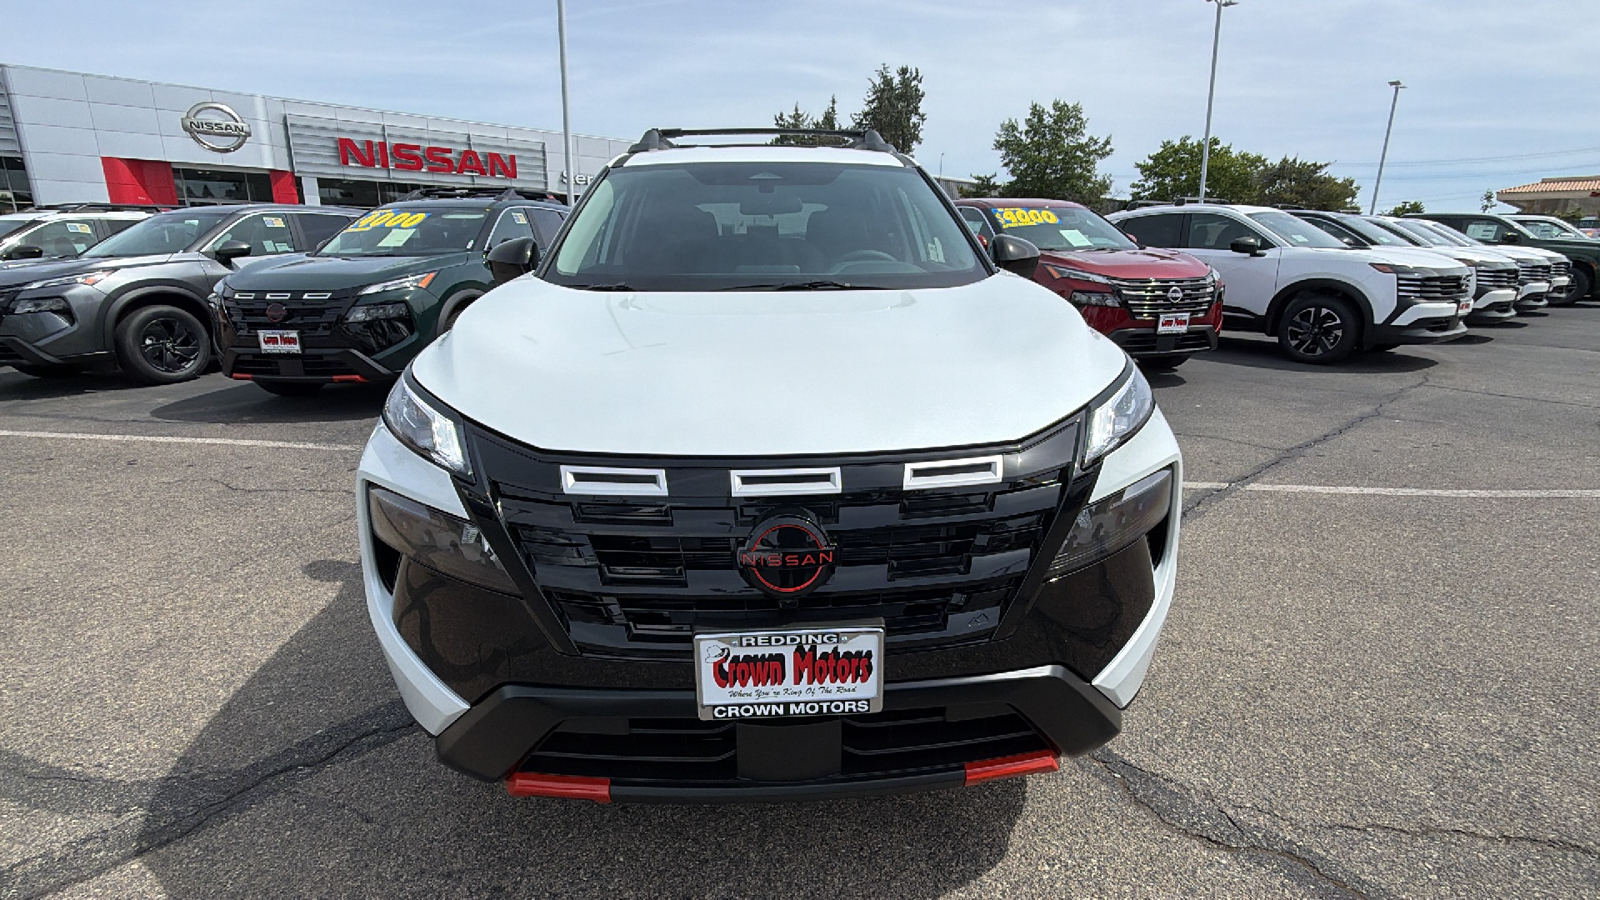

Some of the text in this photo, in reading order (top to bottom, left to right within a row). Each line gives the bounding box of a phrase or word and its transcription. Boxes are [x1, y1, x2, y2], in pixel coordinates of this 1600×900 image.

[189, 121, 244, 133] NISSAN
[338, 137, 518, 179] NISSAN
[742, 551, 833, 567] NISSAN
[741, 634, 838, 647] REDDING
[712, 646, 872, 689] Crown Motors
[728, 689, 752, 698] Where
[783, 687, 802, 697] King
[805, 687, 816, 697] Of
[818, 686, 833, 694] The
[836, 686, 857, 694] Road
[713, 701, 869, 718] CROWN MOTORS
